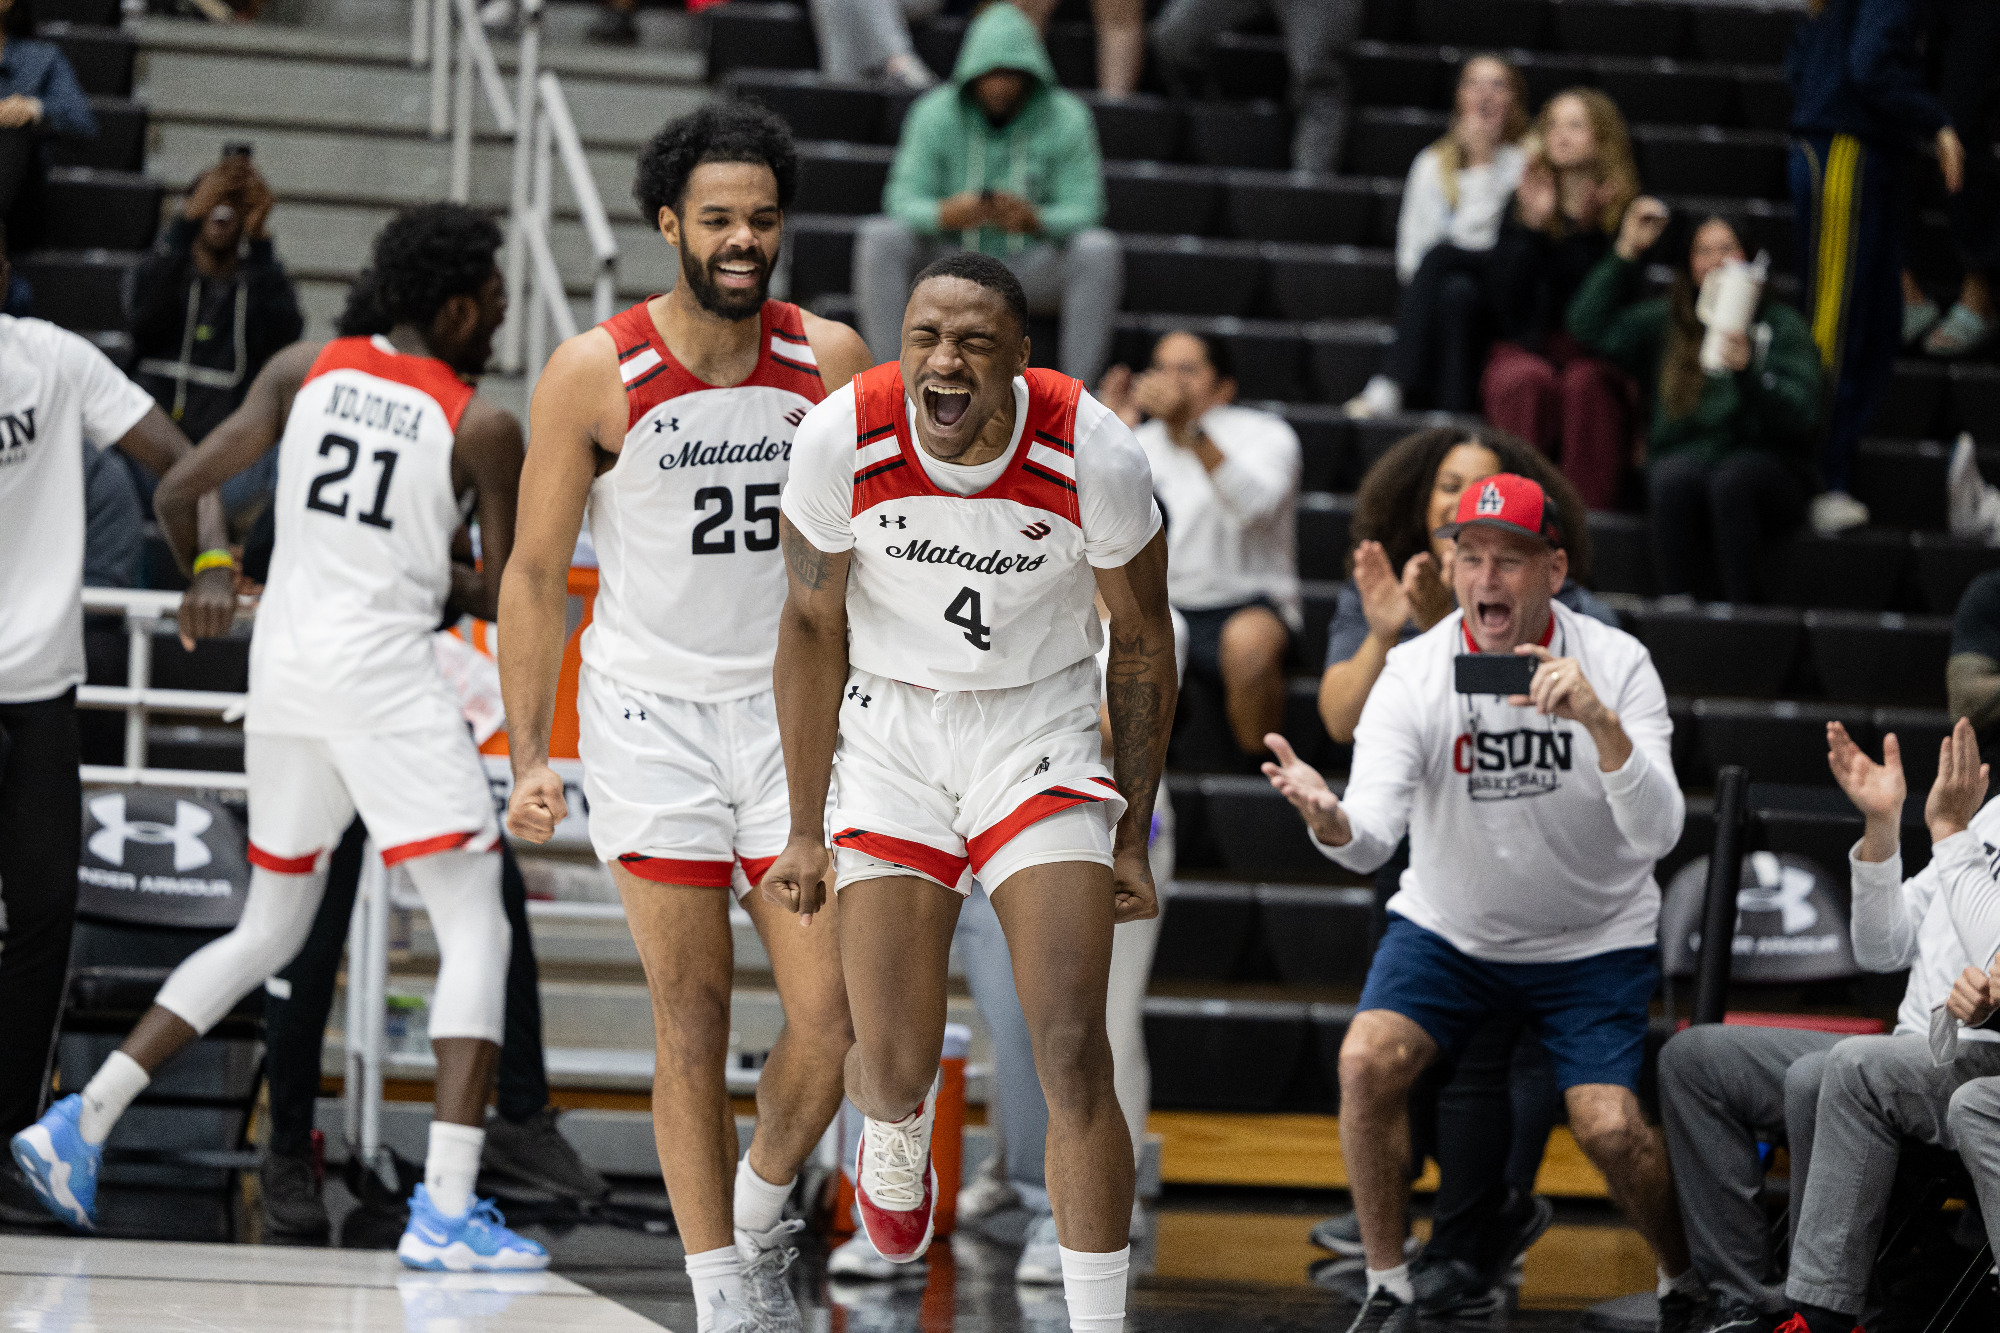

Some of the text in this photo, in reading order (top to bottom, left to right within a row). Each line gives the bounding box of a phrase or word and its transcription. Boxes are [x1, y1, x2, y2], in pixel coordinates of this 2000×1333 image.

[325, 383, 424, 442] NDJONGA
[306, 433, 399, 531] 21
[658, 436, 792, 470] Matador
[692, 482, 781, 556] 25
[885, 539, 1048, 576] Matadors
[943, 585, 991, 652] 4
[1453, 727, 1574, 774] CSUN
